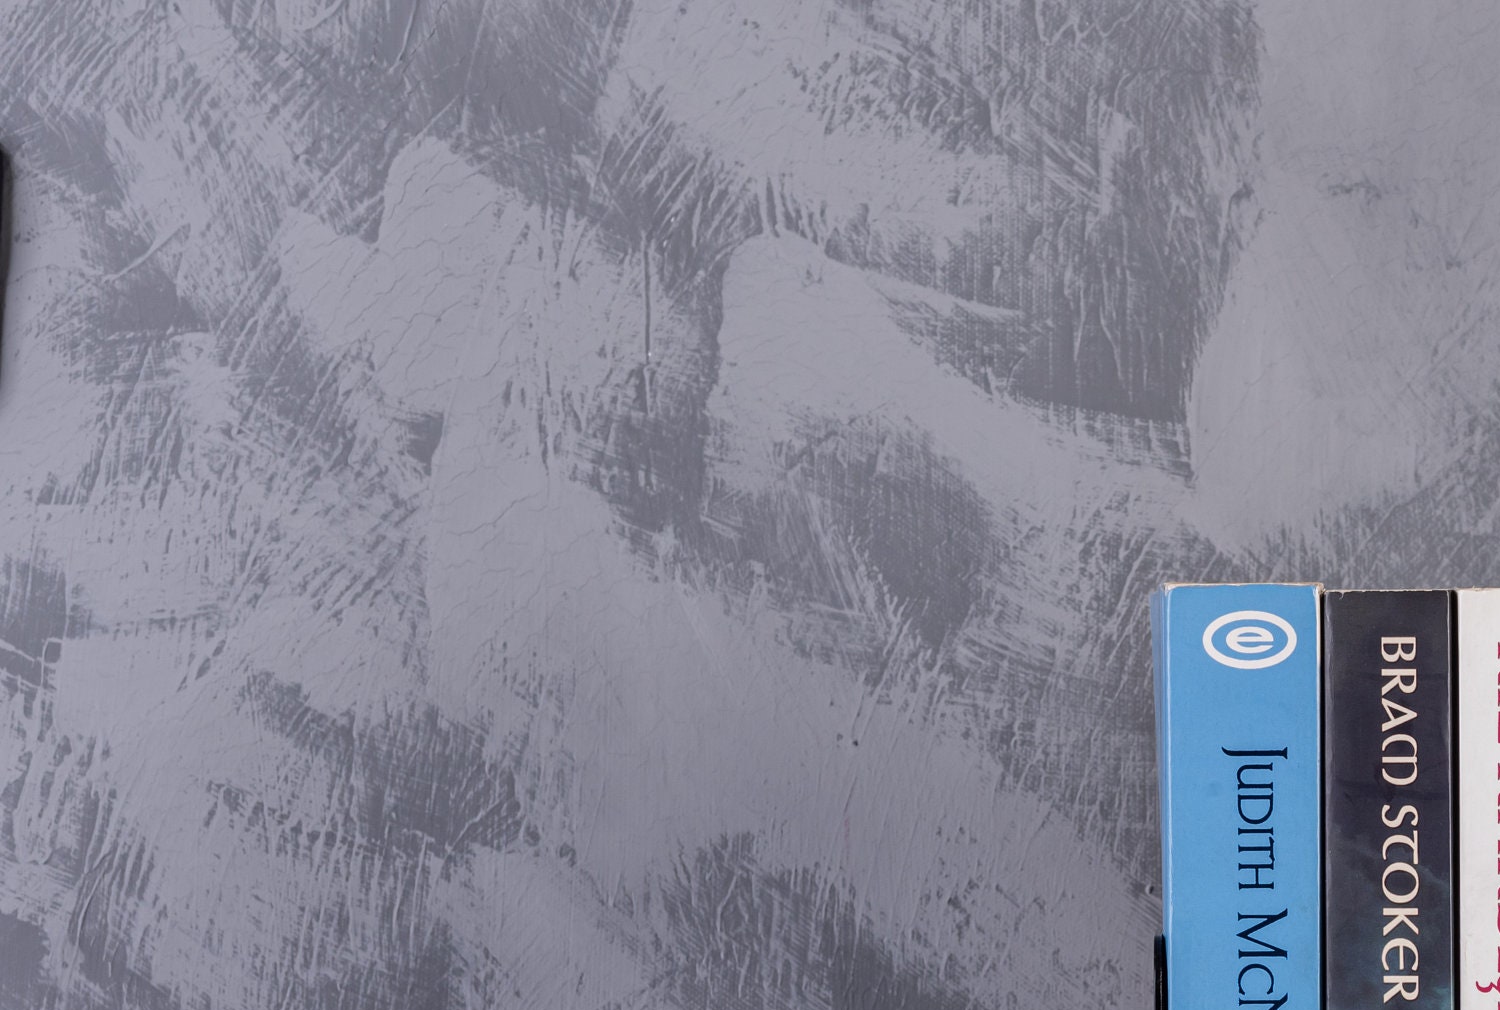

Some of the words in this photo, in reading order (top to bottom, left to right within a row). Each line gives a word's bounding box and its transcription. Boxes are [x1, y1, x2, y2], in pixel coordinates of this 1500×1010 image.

[1379, 635, 1418, 787] BRAM
[1221, 745, 1289, 891] JUDITH
[1381, 804, 1422, 1004] STOKER
